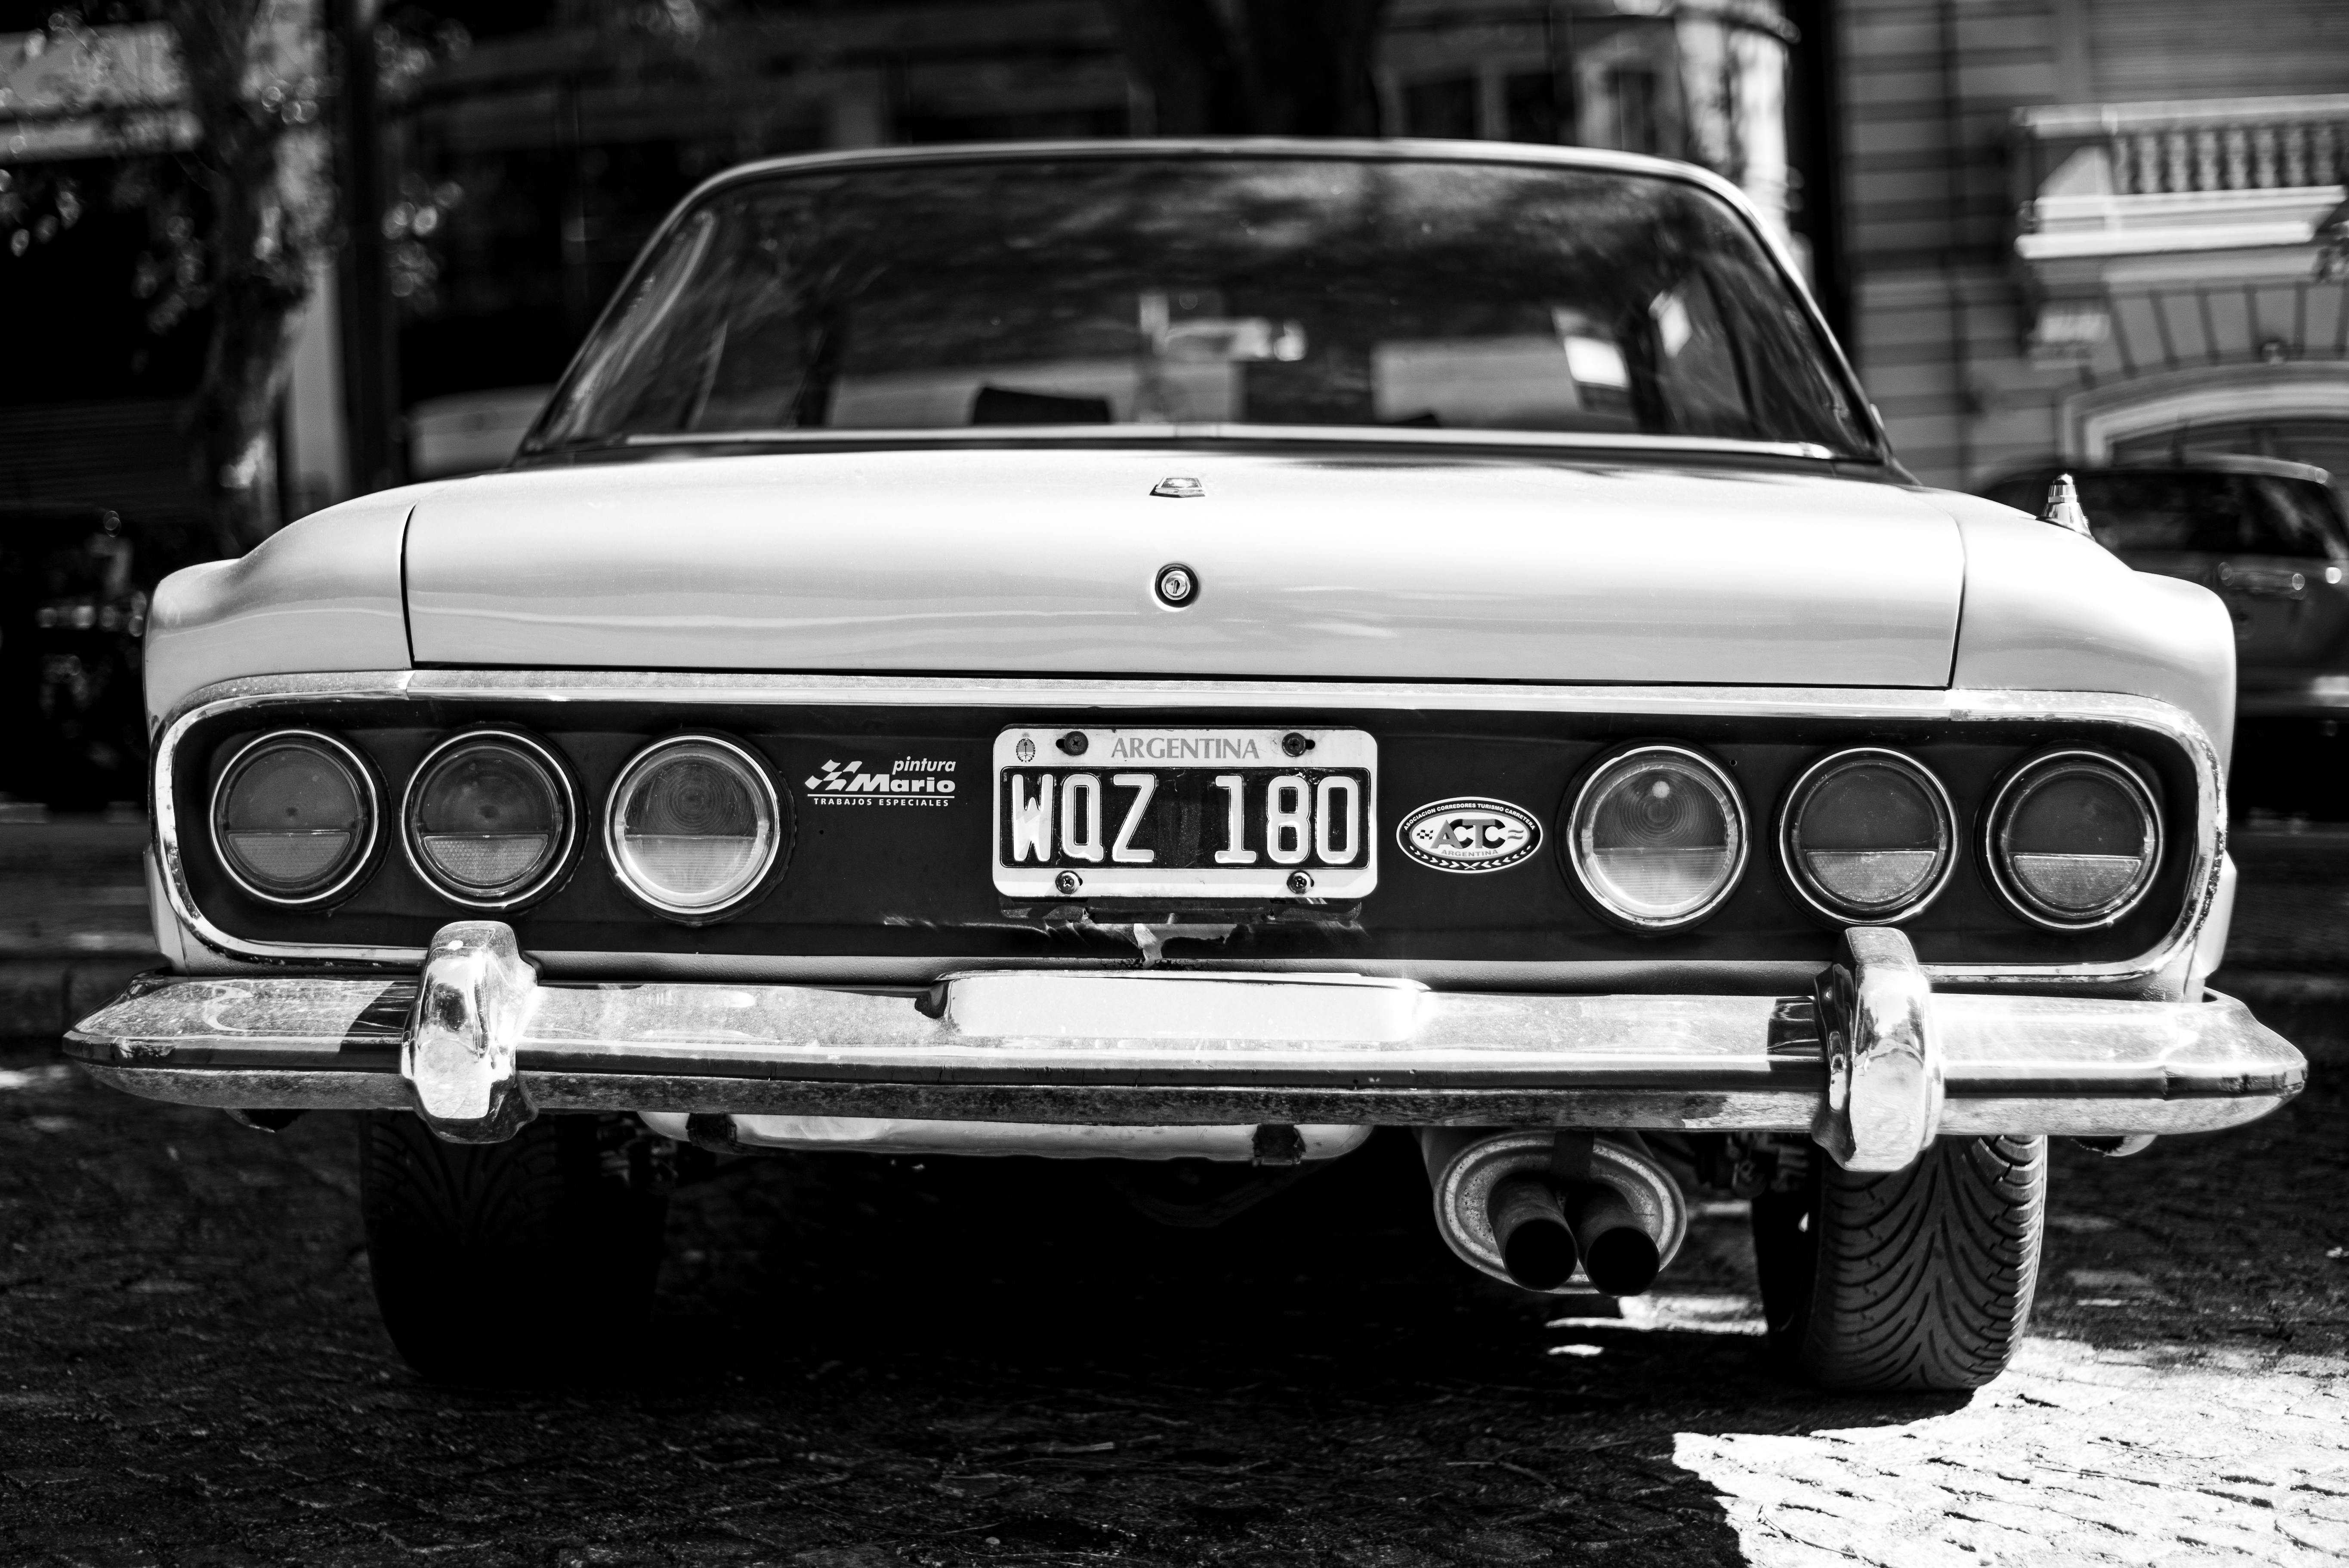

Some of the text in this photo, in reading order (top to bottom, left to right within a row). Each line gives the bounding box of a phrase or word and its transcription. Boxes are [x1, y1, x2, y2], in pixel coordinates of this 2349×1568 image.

[1111, 737, 1260, 759] ARGENTINA
[892, 756, 956, 775] pintura
[845, 774, 956, 793] Mario
[1012, 773, 1360, 864] WQZ 180
[1404, 803, 1535, 830] ASOCIACION CORREDORES TURISMO CARRETERA
[1442, 849, 1498, 857] ARGENTINA
